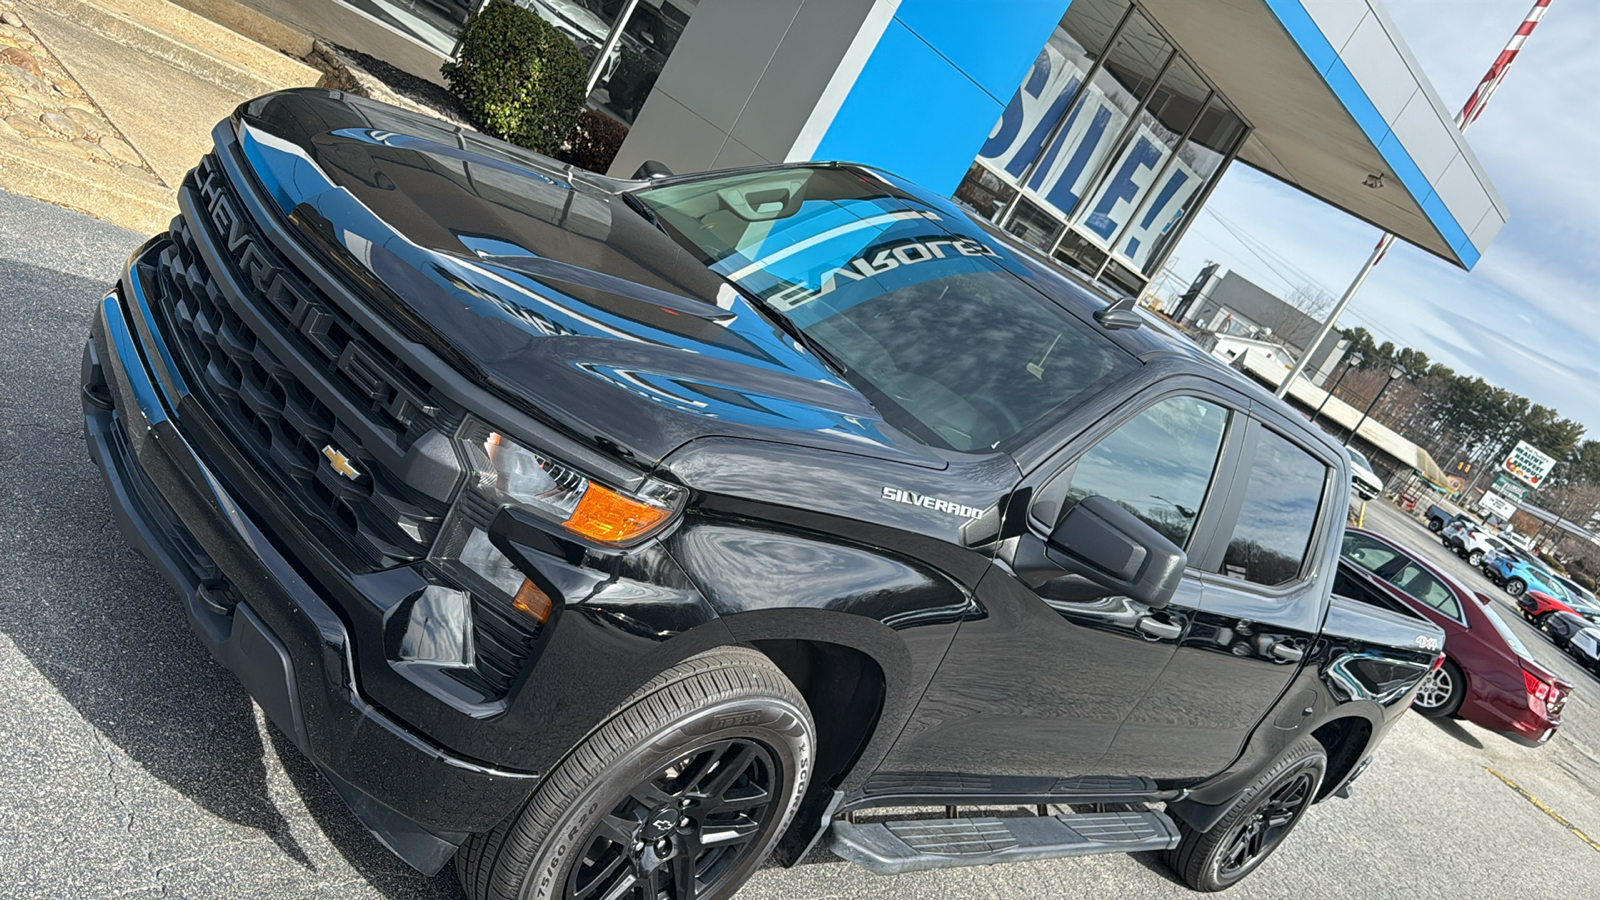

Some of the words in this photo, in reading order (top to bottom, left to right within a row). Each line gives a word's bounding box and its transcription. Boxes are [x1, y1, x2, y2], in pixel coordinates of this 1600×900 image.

[976, 47, 1189, 260] SALE!
[193, 154, 440, 428] CHEVROLET
[1514, 453, 1544, 473] HARVEST
[1515, 446, 1544, 466] HEALTHY
[1513, 460, 1544, 481] PRODUCE
[881, 486, 983, 520] SILVERADO
[711, 709, 762, 730] PIRELLI
[567, 802, 598, 841] R20
